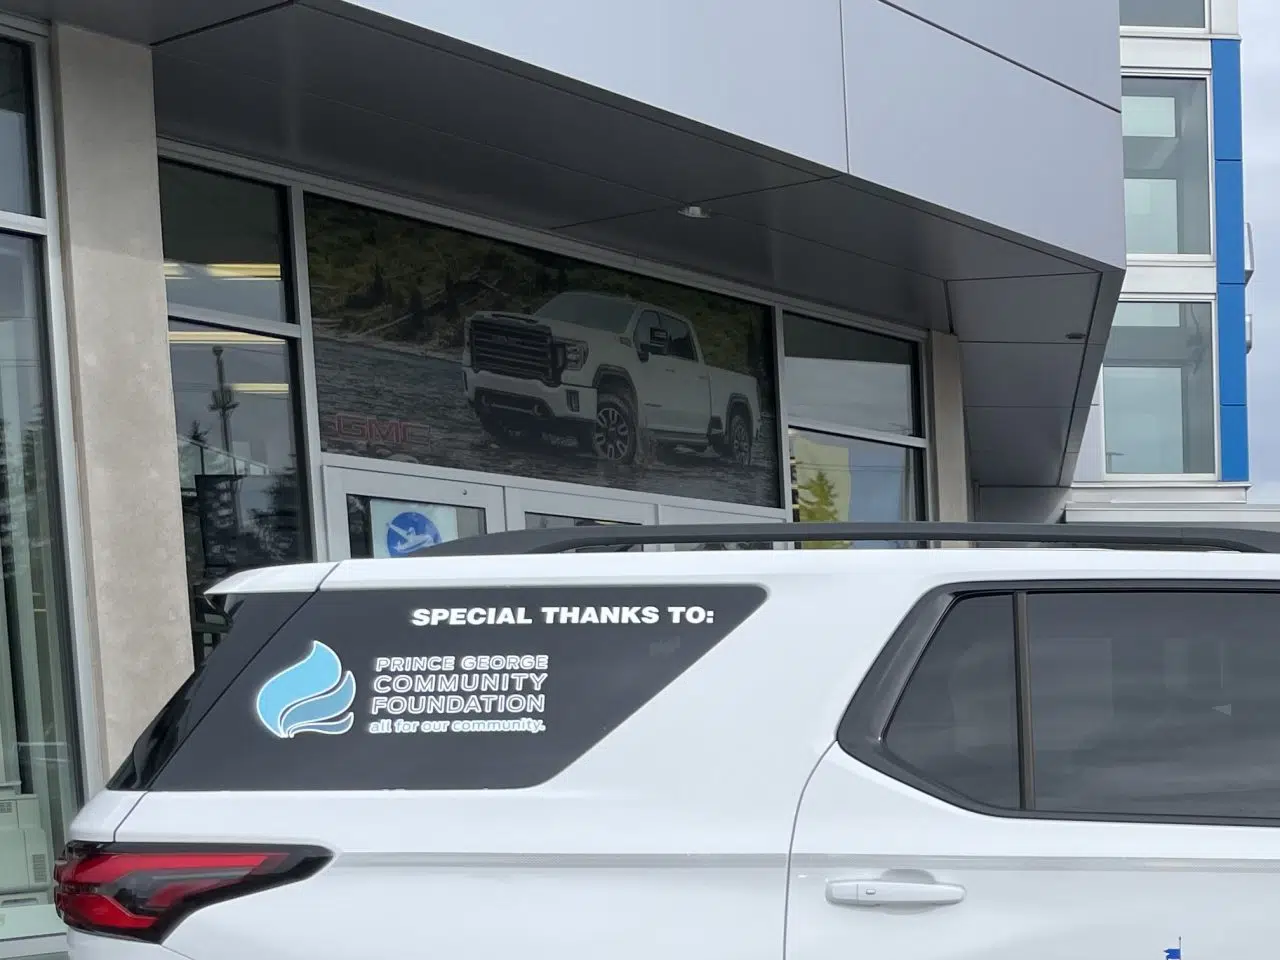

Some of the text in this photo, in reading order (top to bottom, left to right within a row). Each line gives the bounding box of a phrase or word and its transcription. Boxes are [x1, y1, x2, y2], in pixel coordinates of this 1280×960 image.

[411, 606, 714, 626] SPECIAL THANKS TO:
[375, 655, 549, 672] PRINCE GEORGE
[373, 673, 549, 693] COMMUNITY
[371, 694, 546, 715] FOUNDATION
[369, 717, 546, 734] all for our community.
